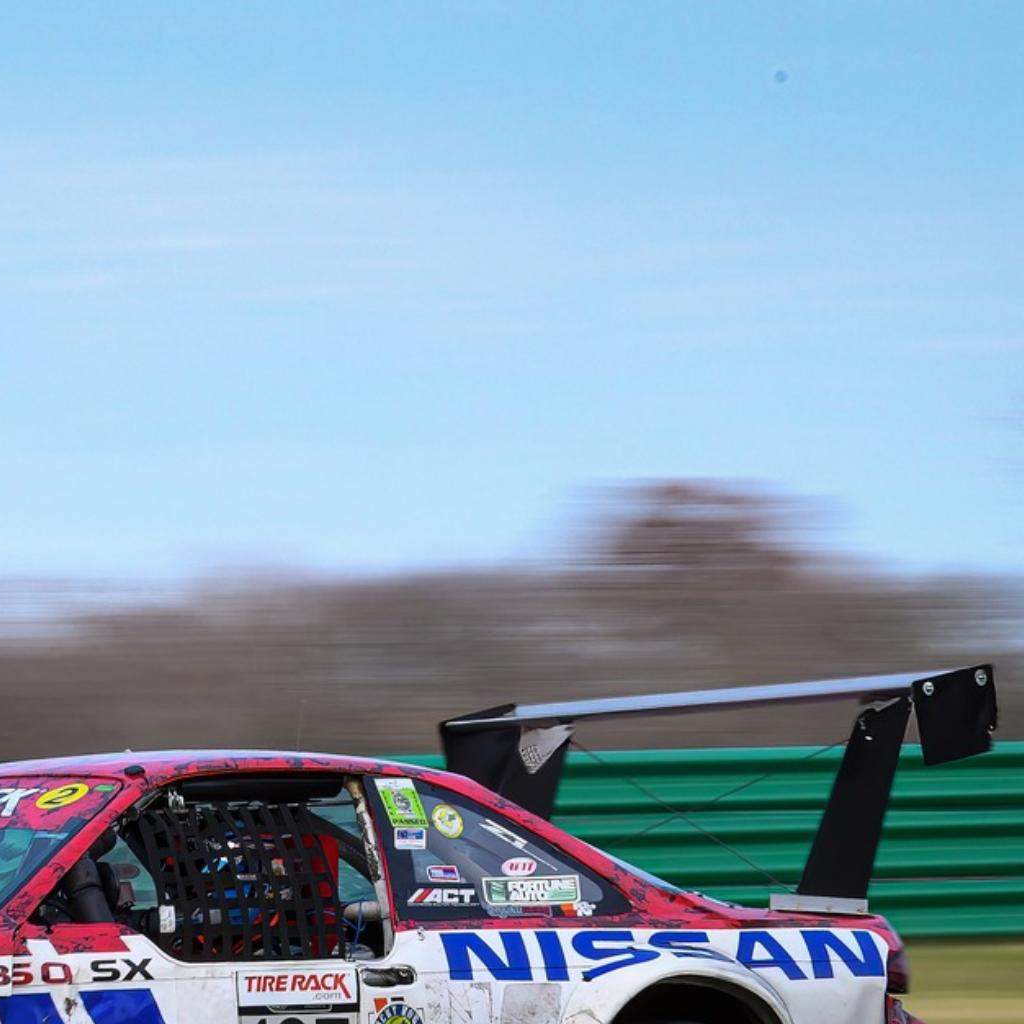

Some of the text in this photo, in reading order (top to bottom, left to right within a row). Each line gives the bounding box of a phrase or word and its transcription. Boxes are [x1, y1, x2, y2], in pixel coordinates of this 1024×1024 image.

[43, 786, 80, 805] 2
[507, 878, 577, 892] FORTUNE
[509, 891, 549, 902] AUTO
[439, 930, 887, 982] NISSAN
[90, 958, 154, 982] SX
[244, 972, 352, 999] TIRE RACK
